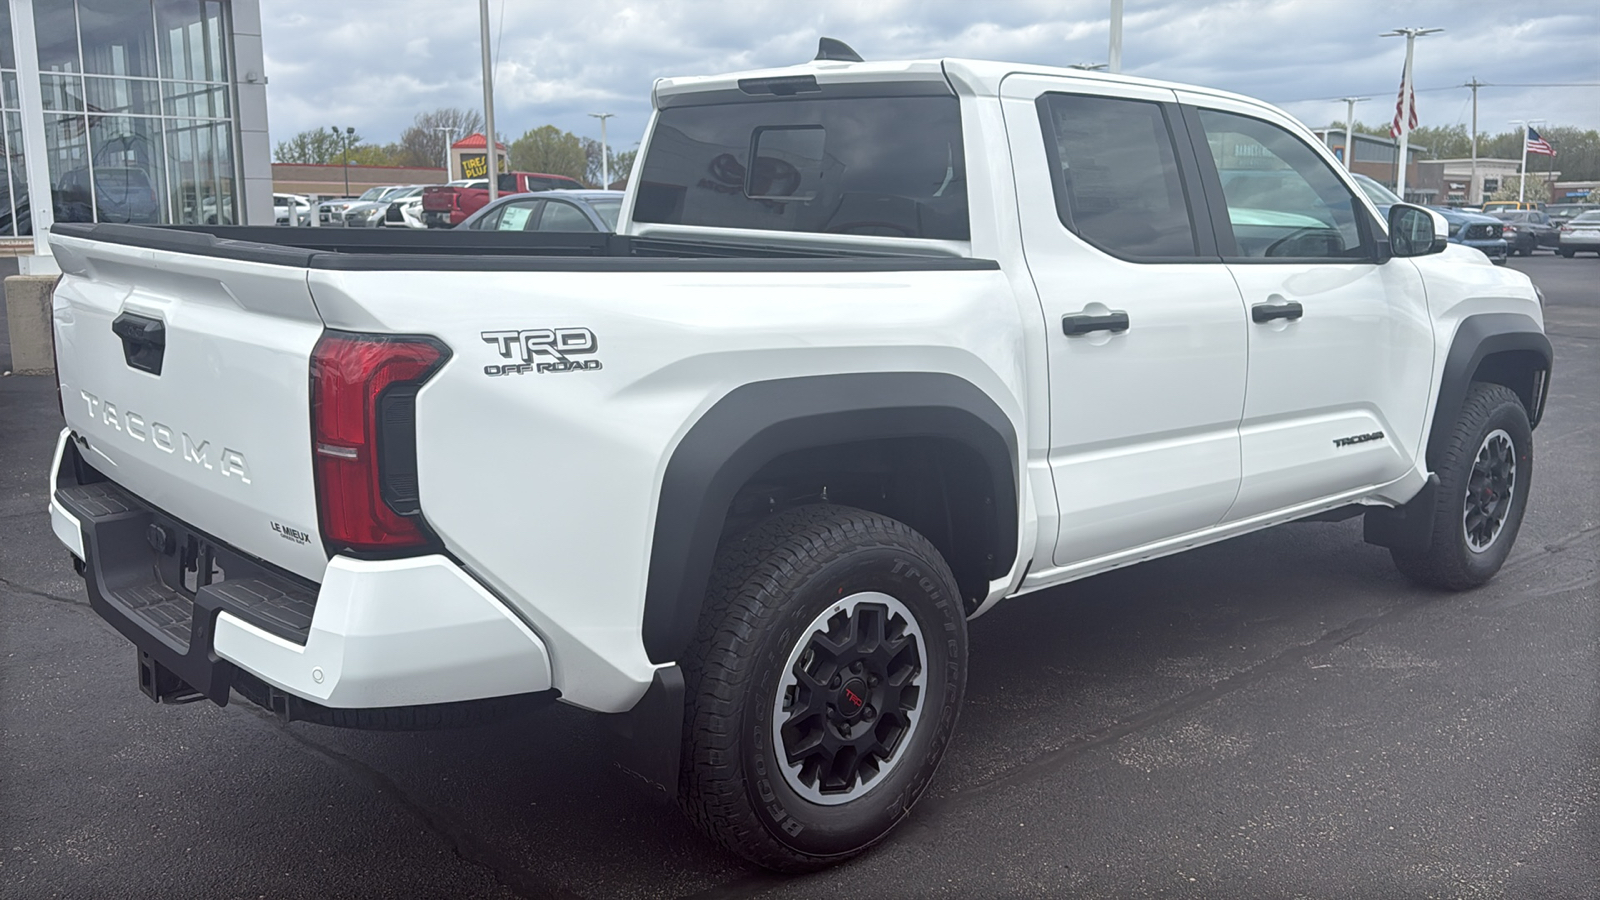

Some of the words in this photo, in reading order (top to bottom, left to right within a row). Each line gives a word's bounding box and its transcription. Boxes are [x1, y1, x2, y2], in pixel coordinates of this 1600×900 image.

[462, 156, 486, 170] TIRES
[465, 165, 488, 178] PLUS
[480, 327, 599, 364] TRD
[484, 363, 534, 377] OFF
[536, 360, 603, 374] ROAD
[81, 389, 252, 485] TACOMA
[1332, 431, 1385, 448] TACOMA
[270, 521, 282, 533] LE
[281, 525, 312, 544] MIEUX
[846, 688, 863, 707] TRD
